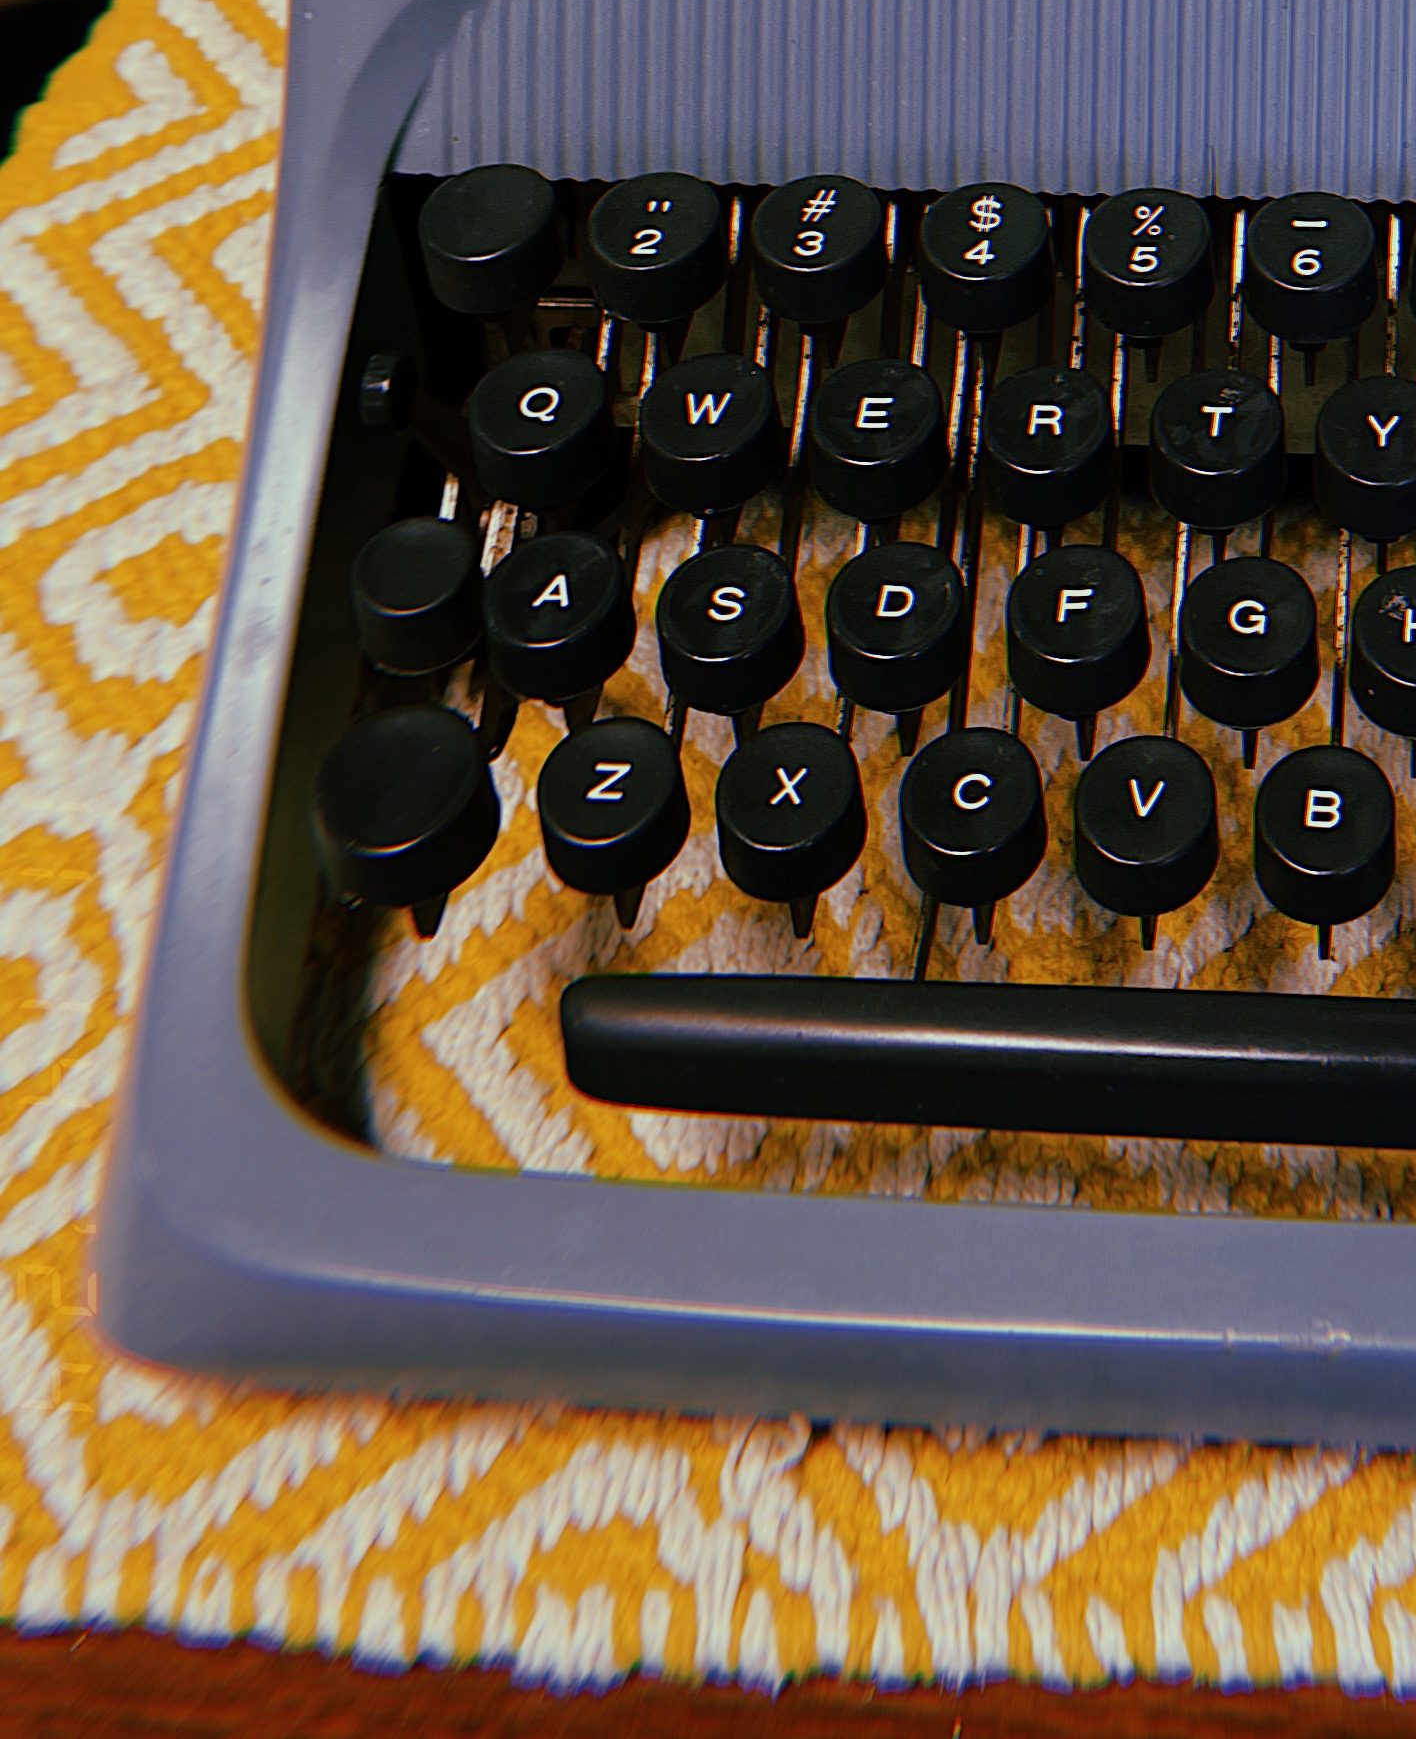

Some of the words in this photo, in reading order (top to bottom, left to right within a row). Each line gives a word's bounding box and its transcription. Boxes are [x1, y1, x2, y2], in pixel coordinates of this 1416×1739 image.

[801, 189, 838, 223] #
[968, 195, 1004, 233] $
[1131, 205, 1166, 236] %
[629, 228, 665, 255] 2
[792, 230, 827, 257] 3
[962, 239, 997, 266] 4
[1128, 245, 1161, 273] 5
[1291, 248, 1323, 276] 6
[519, 386, 561, 422] Q
[685, 392, 734, 425] W
[854, 397, 896, 429] E
[1026, 404, 1065, 436] R
[1200, 405, 1236, 437] T
[1366, 414, 1402, 448] Y
[531, 574, 570, 608] A
[707, 586, 748, 621] S
[875, 584, 917, 618] D
[1055, 588, 1096, 623] F
[1227, 599, 1269, 635] G
[586, 762, 632, 802] Z
[769, 767, 809, 805] X
[951, 773, 994, 810] C
[1128, 778, 1167, 817] V
[1303, 789, 1344, 829] B
